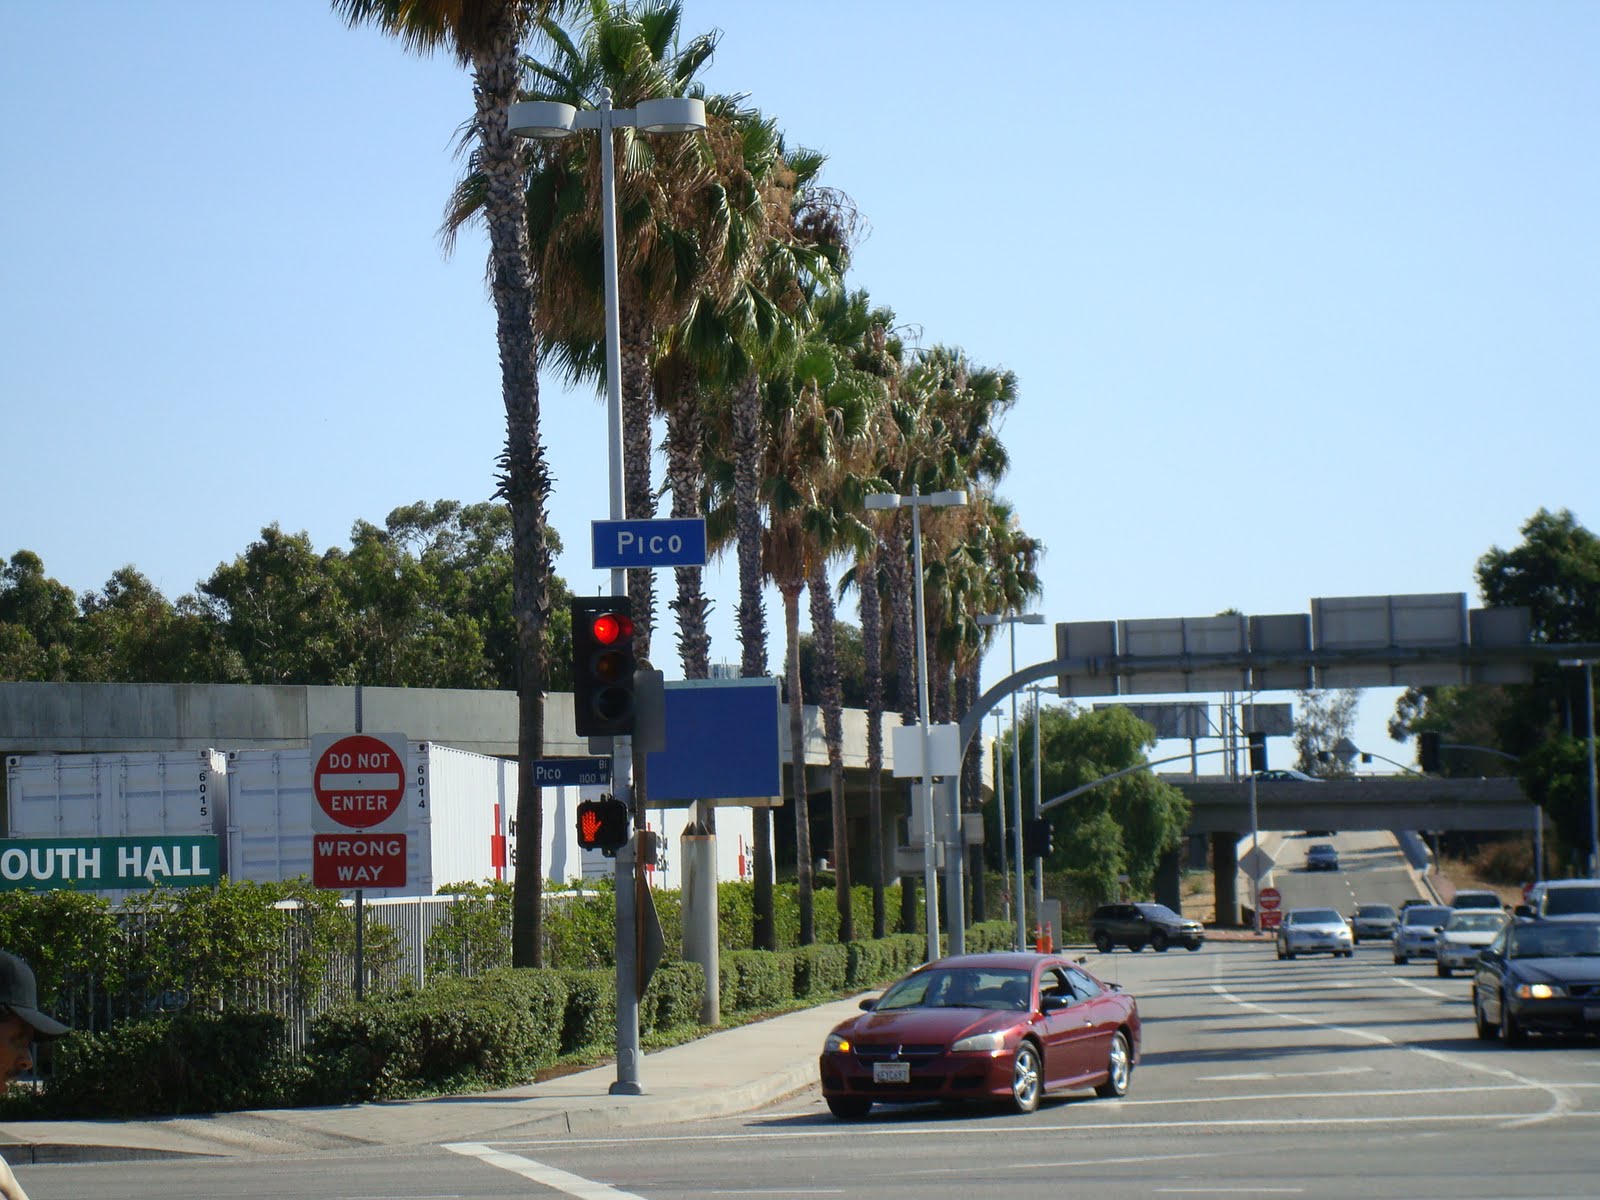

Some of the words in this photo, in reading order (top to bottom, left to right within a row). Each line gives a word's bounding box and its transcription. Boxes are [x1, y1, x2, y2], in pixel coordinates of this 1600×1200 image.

[329, 753, 351, 769] DO
[358, 753, 390, 768] NOT
[579, 774, 596, 783] 1100
[600, 773, 607, 782] W
[199, 772, 207, 817] 6015
[417, 765, 425, 809] 6014
[331, 795, 387, 811] ENTER
[318, 841, 400, 857] WRONG
[0, 848, 101, 880] OUTH
[117, 845, 211, 878] HALL
[337, 866, 384, 881] WAY
